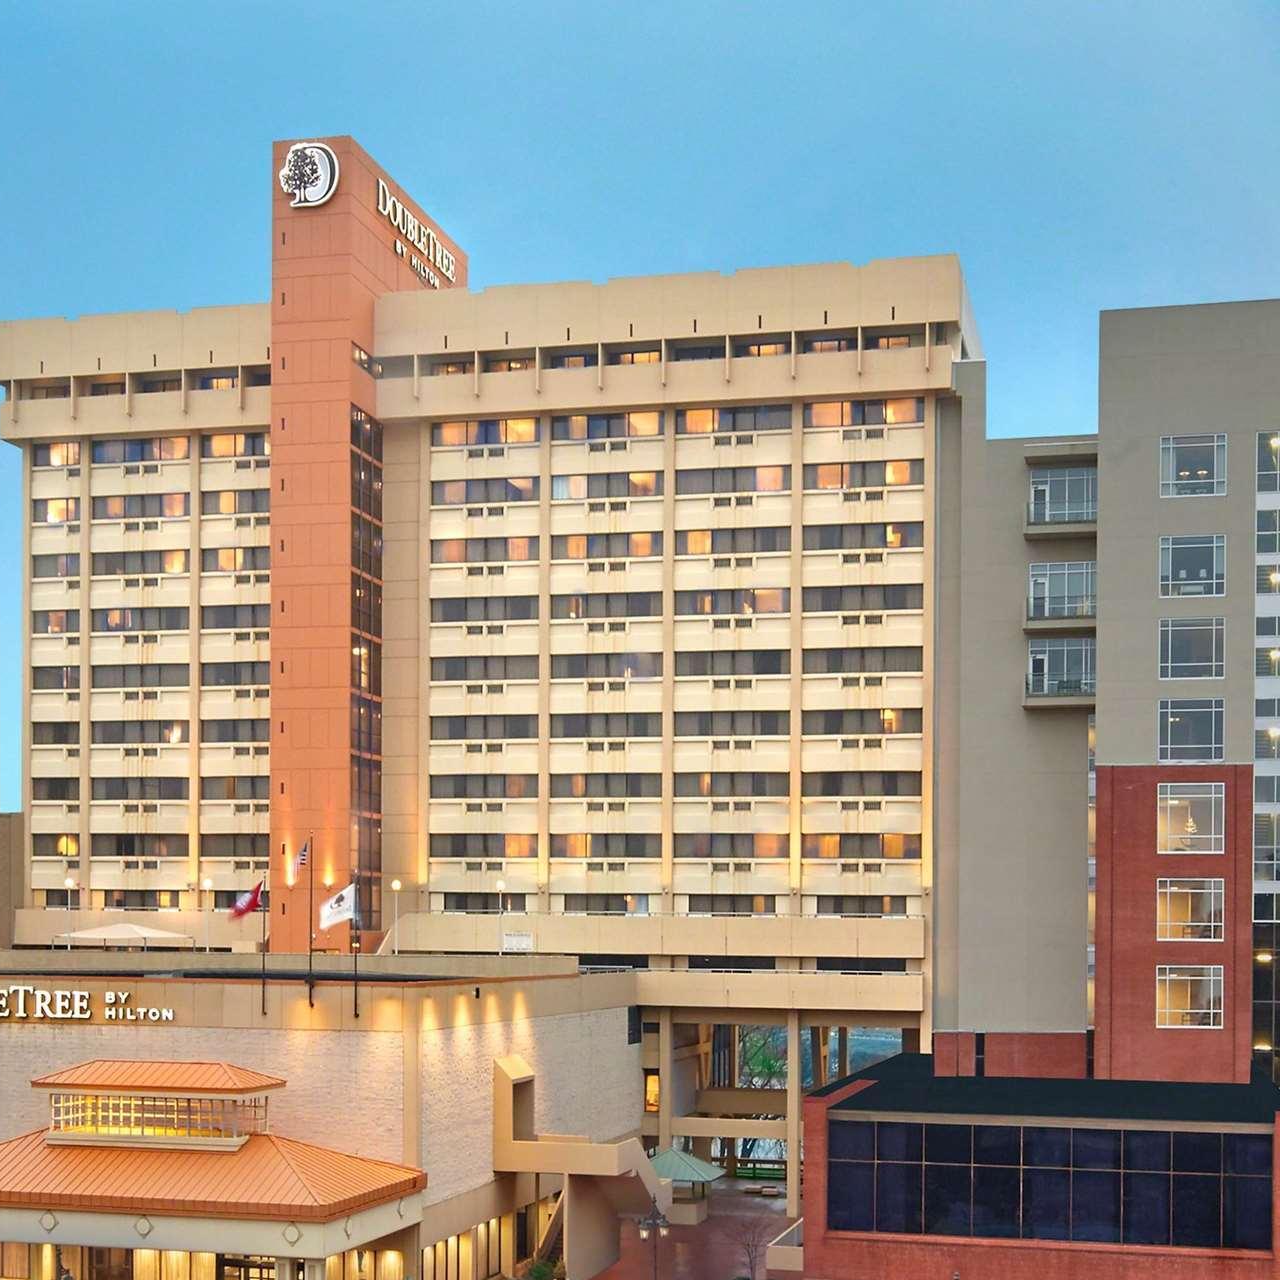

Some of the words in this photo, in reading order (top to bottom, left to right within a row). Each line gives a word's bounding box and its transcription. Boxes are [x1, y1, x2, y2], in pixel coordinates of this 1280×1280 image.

[394, 239, 407, 258] BY
[410, 254, 439, 289] HILTON
[104, 991, 130, 1004] BY
[104, 1007, 175, 1021] HILTON
